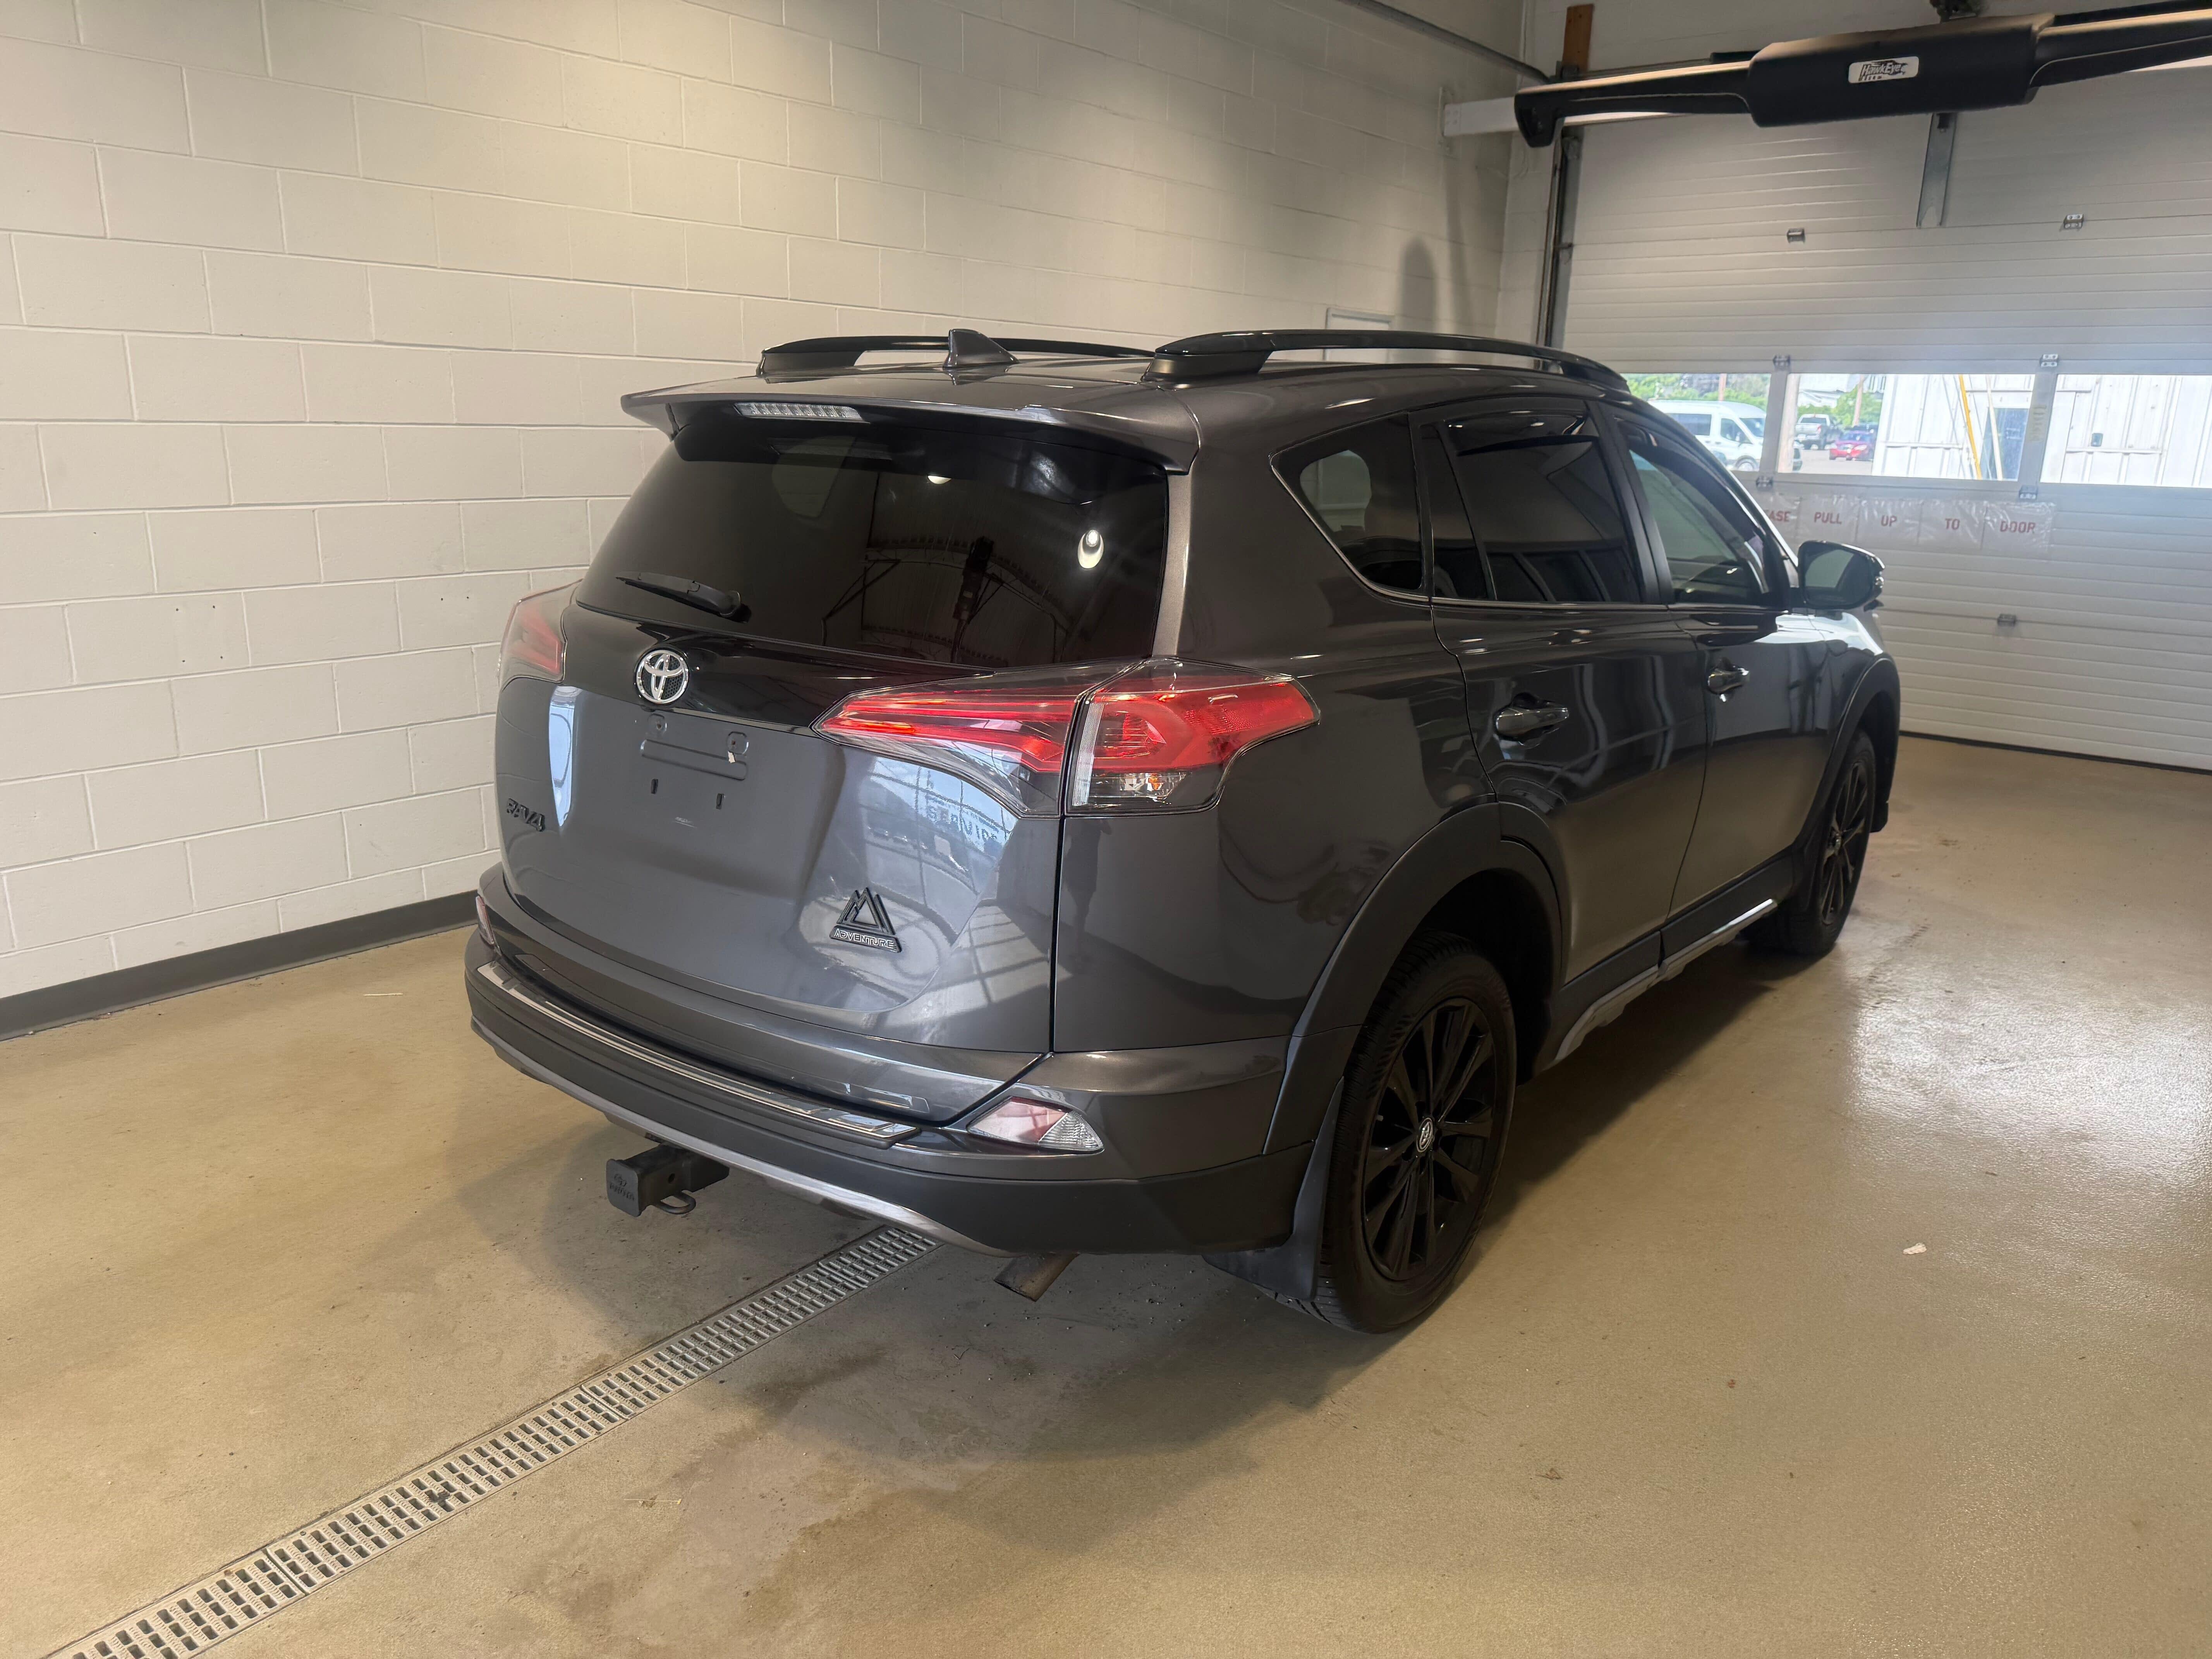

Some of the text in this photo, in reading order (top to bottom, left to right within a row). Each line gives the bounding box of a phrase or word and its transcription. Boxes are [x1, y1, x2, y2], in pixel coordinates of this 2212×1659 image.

[1814, 512, 1842, 524] PULL
[1881, 515, 1897, 527] UP
[1946, 518, 1960, 530] TO
[2000, 520, 2035, 534] DOOR
[507, 798, 545, 832] RAV4
[834, 928, 894, 949] ADVENTURE
